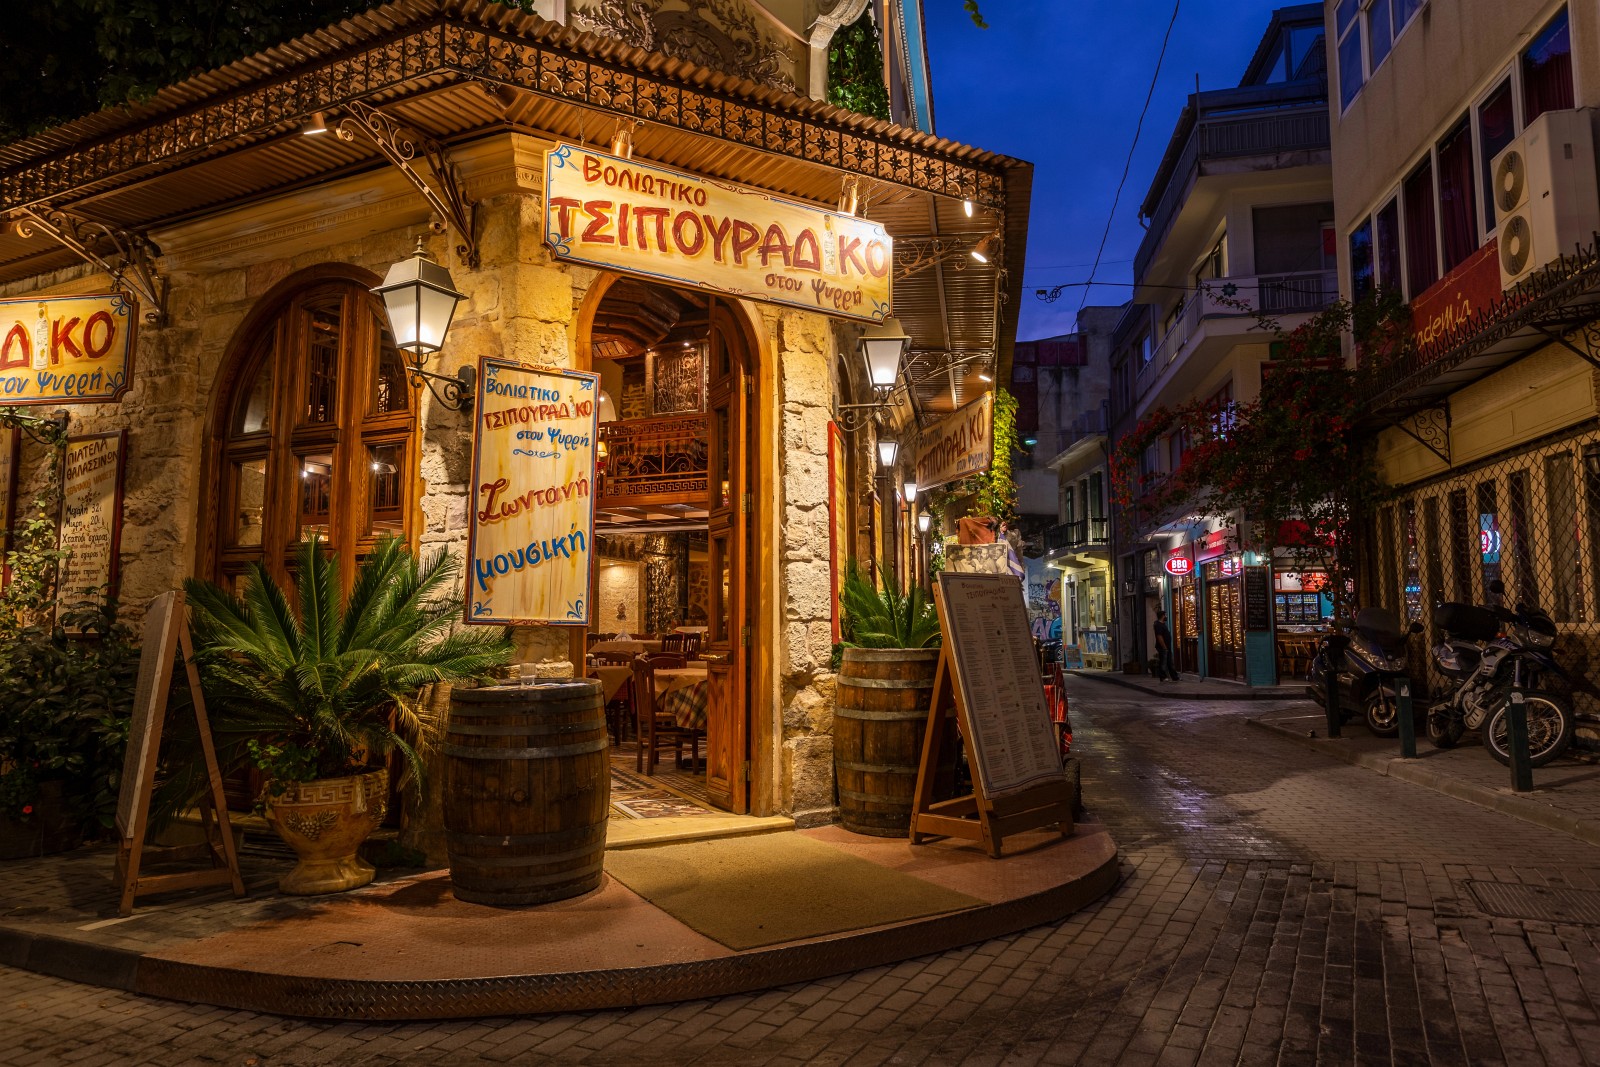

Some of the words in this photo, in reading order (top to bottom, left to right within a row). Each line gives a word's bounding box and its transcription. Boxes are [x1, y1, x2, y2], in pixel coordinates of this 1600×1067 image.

[583, 155, 707, 207] ΒΟΛΙΩΤΙΚΟ
[485, 378, 561, 402] ΒΟΛΙΩΤΙΚΟ
[478, 470, 589, 522] Ζωντανή
[475, 522, 586, 592] μουσική
[1171, 559, 1188, 569] BBQ
